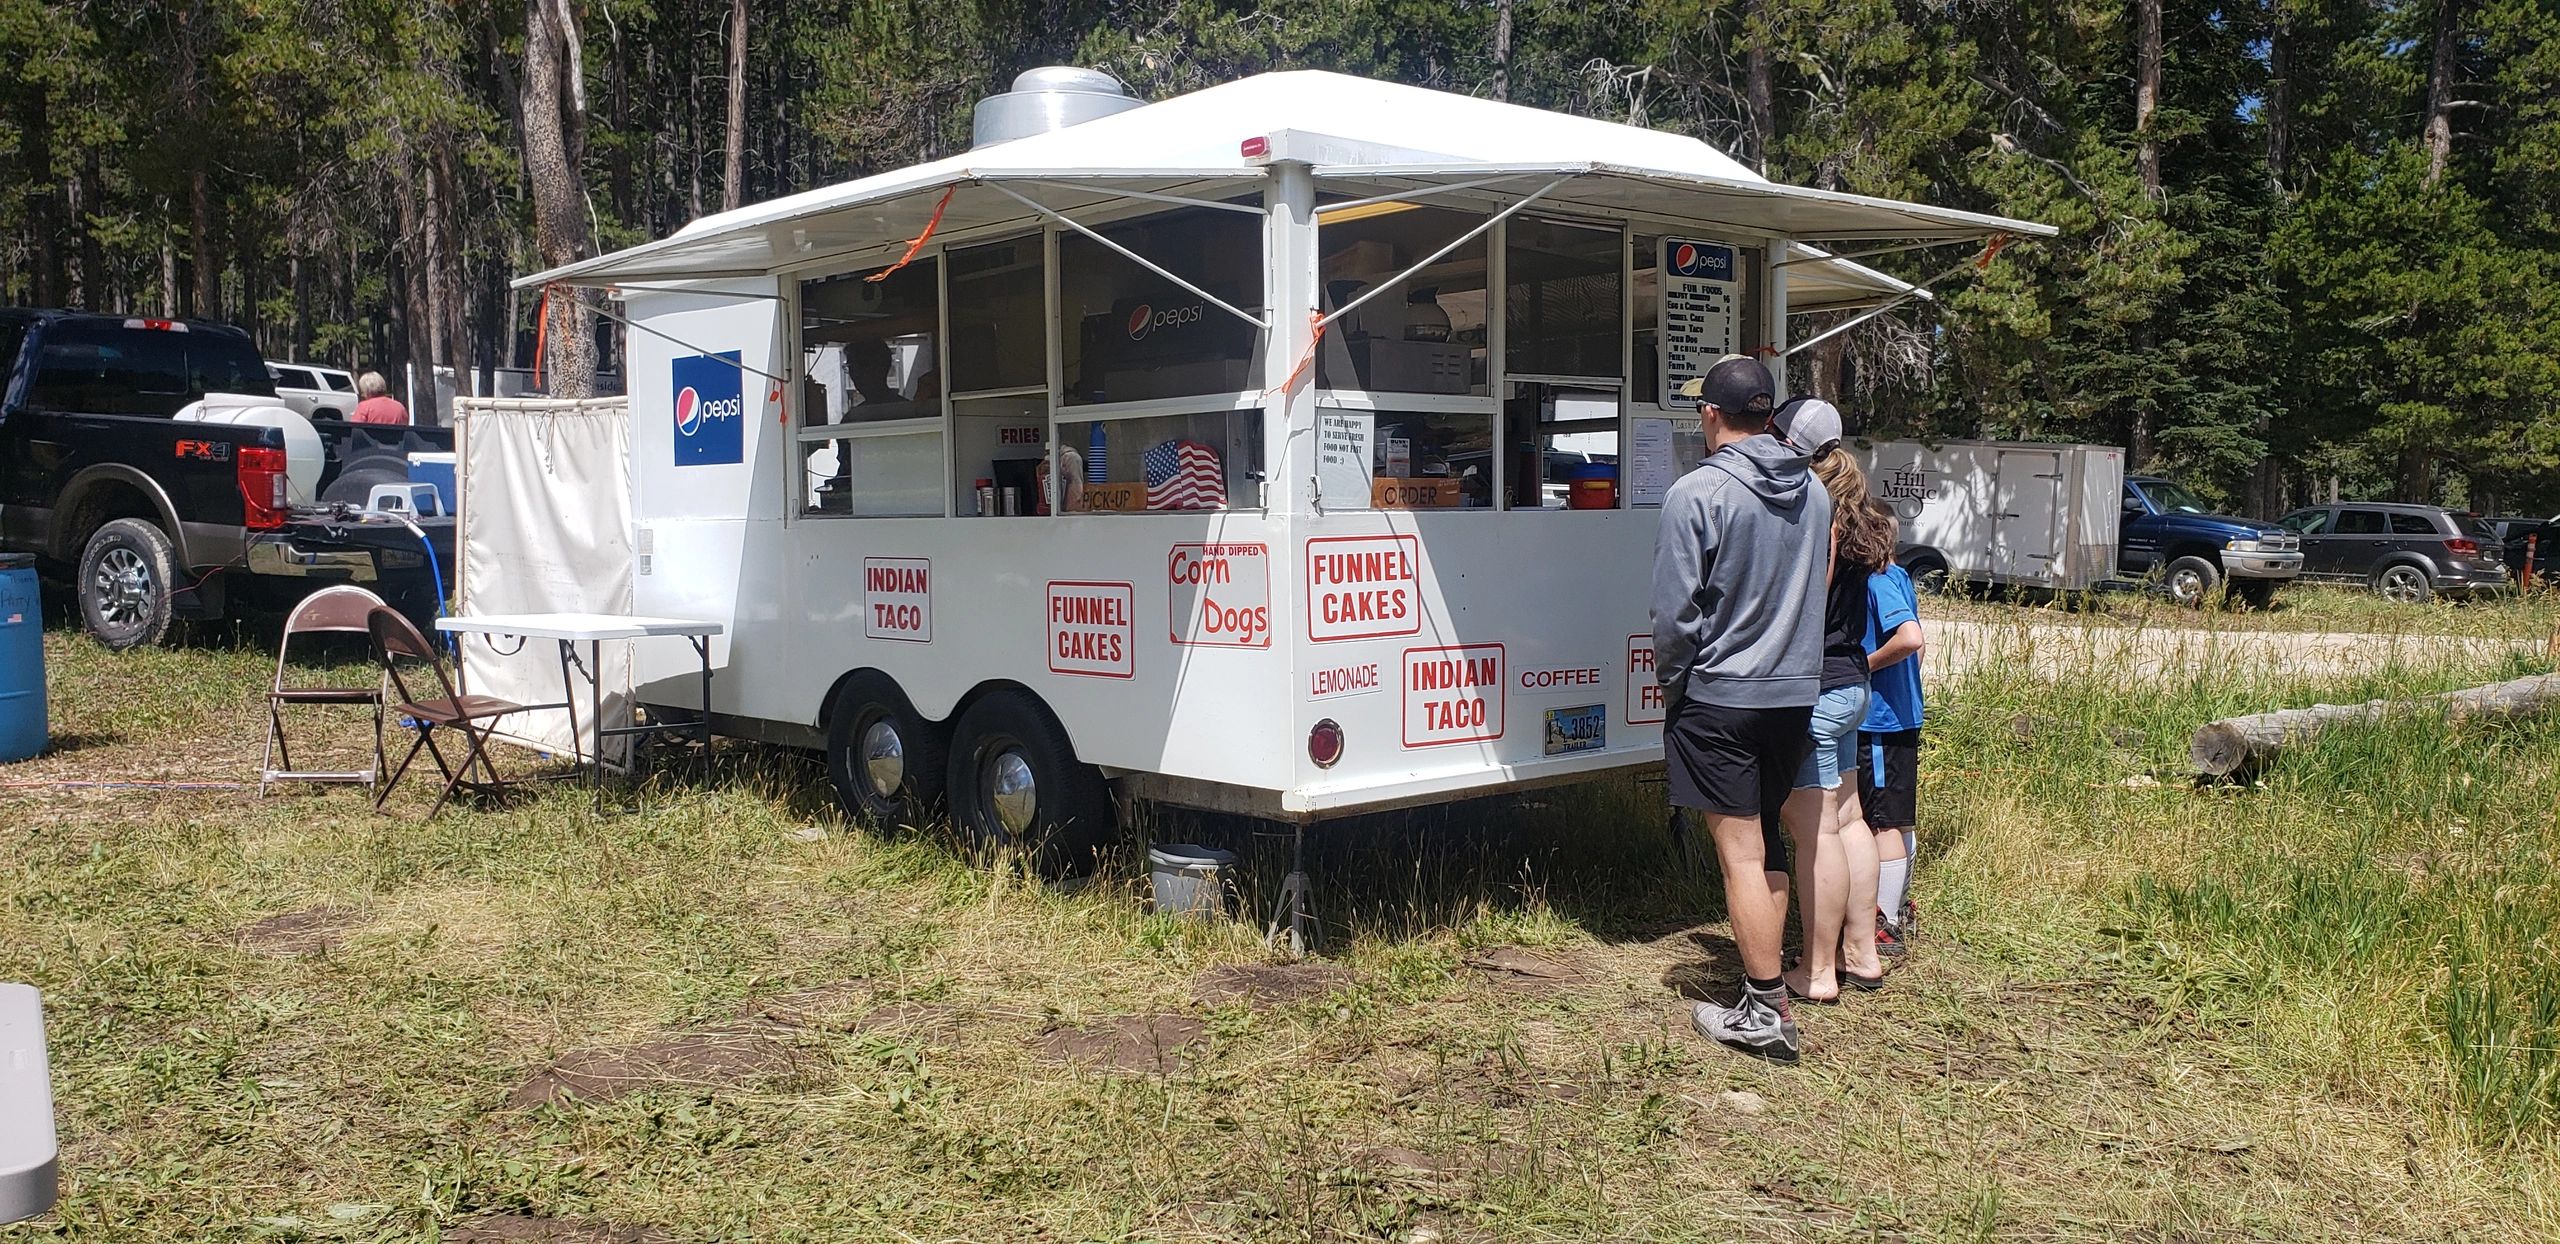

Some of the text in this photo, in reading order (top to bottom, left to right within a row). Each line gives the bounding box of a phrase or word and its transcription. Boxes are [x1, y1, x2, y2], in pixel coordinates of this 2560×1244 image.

[1700, 255, 1727, 271] pepsi
[1702, 286, 1723, 296] FOODS
[1153, 300, 1204, 333] pepsi
[1726, 305, 1730, 314] 4
[1689, 324, 1704, 333] TACO
[1726, 316, 1730, 325] 7
[1668, 333, 1730, 346] CORN DOG 5
[1668, 352, 1686, 361] FRIES
[1668, 361, 1697, 371] FRITO PIE
[703, 393, 740, 423] pepsi
[1324, 418, 1362, 429] WE ARE HAPPY
[1001, 427, 1040, 444] FRIES
[1324, 430, 1364, 442] TO SERVE FRESH
[175, 440, 230, 461] FX4
[1323, 442, 1362, 454] FOOD NOT FAST
[1323, 455, 1337, 464] FOOD
[1894, 472, 1925, 487] Hill
[1083, 489, 1131, 508] PICK-UP
[1384, 485, 1437, 506] ORDER
[1203, 546, 1258, 556] HAND DIPPED
[1171, 551, 1230, 584] Corn
[1314, 551, 1412, 585] FUNNEL
[867, 567, 927, 593] INDIAN
[1052, 596, 1127, 626] FUNNEL
[1322, 588, 1407, 624] CAKES
[874, 603, 921, 630] TACO
[1205, 597, 1266, 643] Dogs
[1058, 631, 1122, 662] CAKES
[1631, 649, 1654, 673] FR
[1311, 664, 1379, 695] LEMONADE
[1412, 657, 1496, 691] INDIAN
[1521, 668, 1601, 688] COFFEE
[1641, 685, 1665, 710] FR
[1423, 697, 1486, 731] TACO
[1571, 715, 1600, 740] 3852
[1563, 741, 1587, 751] TRAILER
